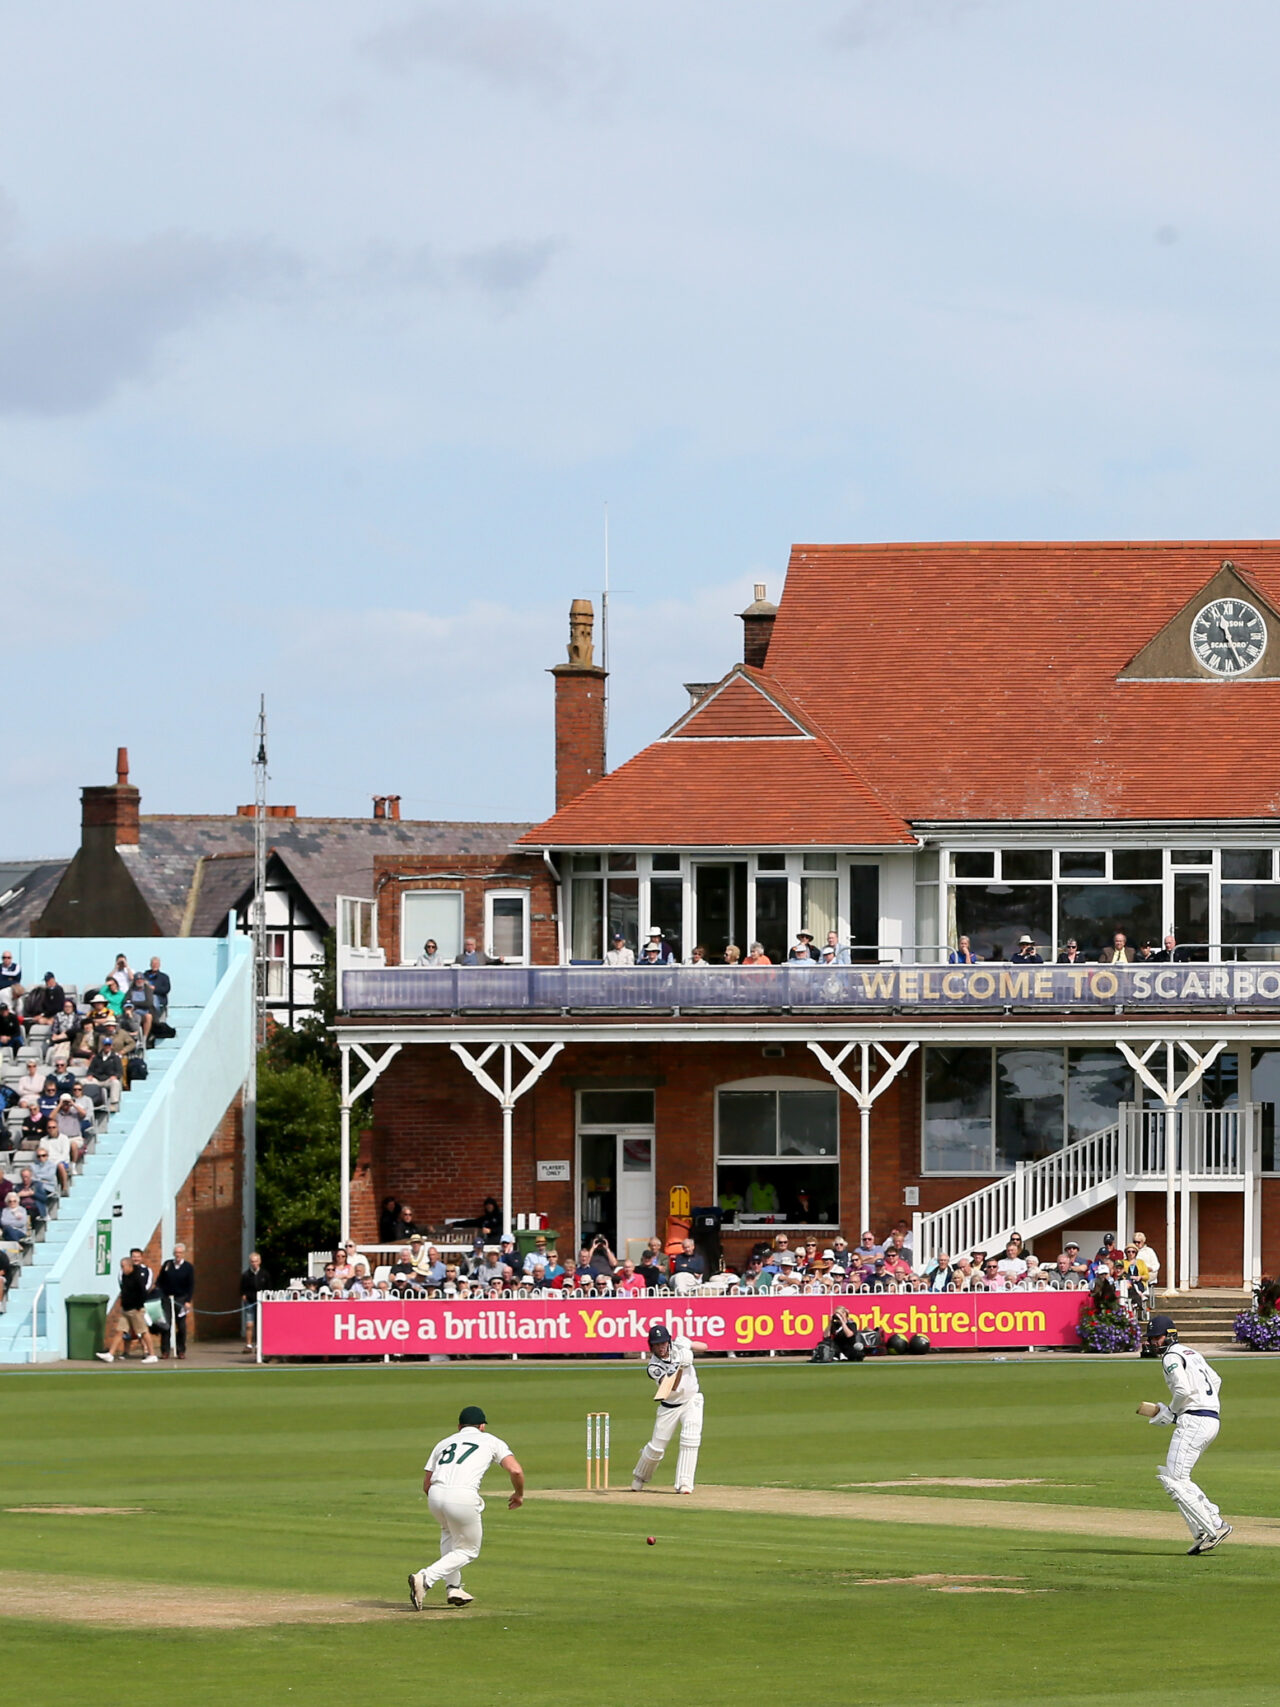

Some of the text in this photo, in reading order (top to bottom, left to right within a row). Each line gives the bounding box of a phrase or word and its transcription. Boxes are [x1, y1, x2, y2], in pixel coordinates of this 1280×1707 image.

[862, 971, 1054, 999] WELCOME
[1068, 971, 1119, 999] TO
[334, 1313, 410, 1341] Have
[417, 1318, 438, 1341] a
[444, 1310, 572, 1340] brilliant
[734, 1314, 774, 1344] go
[781, 1309, 814, 1336] to
[438, 1441, 480, 1466] 87
